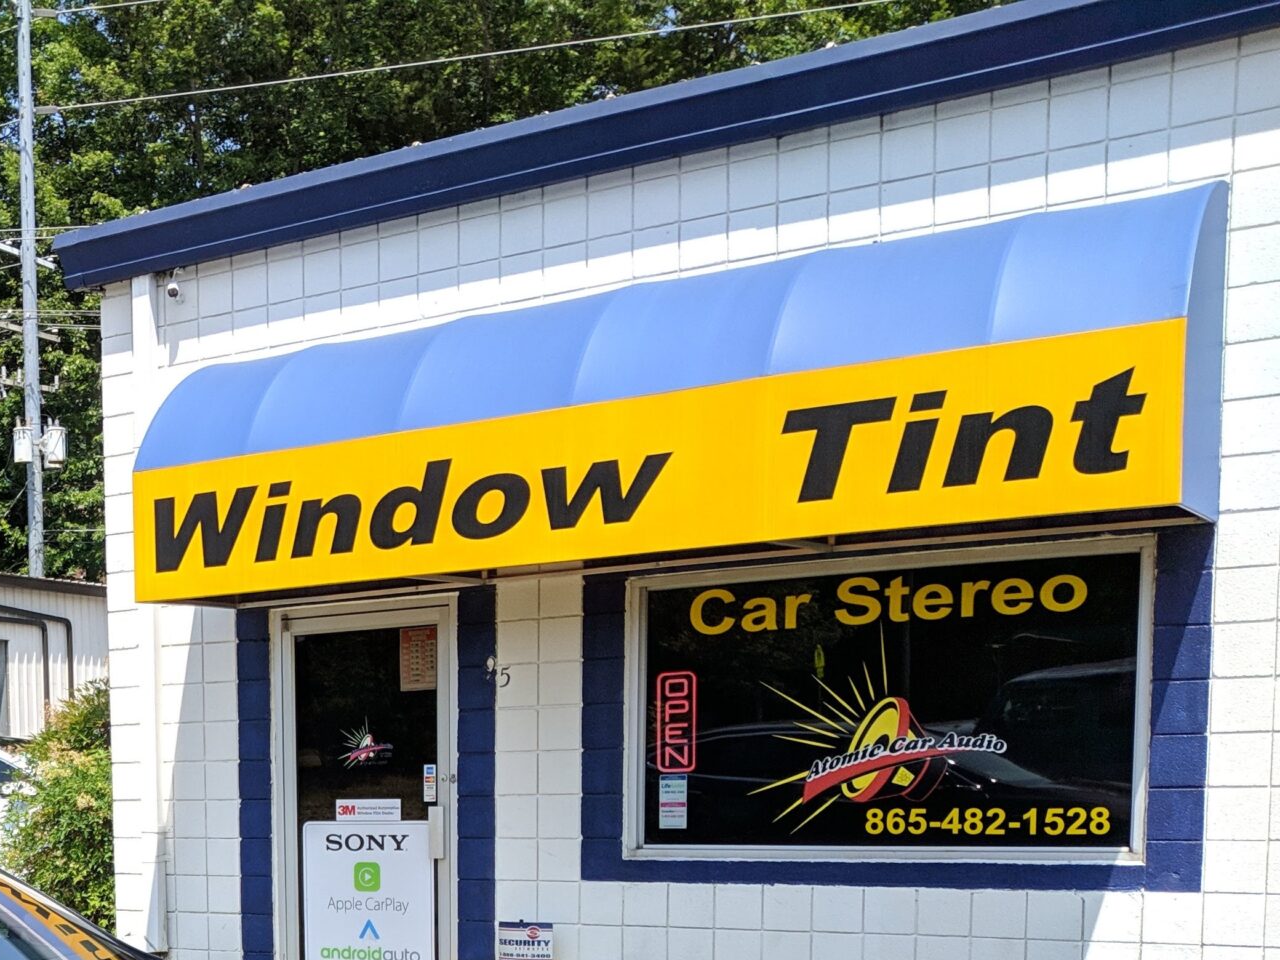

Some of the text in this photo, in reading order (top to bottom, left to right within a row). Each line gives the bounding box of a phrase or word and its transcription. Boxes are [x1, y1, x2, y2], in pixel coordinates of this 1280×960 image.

[152, 365, 1147, 572] Window Tint
[689, 574, 1088, 635] Car Stereo
[664, 678, 689, 767] OPEN
[806, 731, 1007, 781] Atomic Car Audio
[337, 805, 356, 816] 3M
[865, 807, 1111, 836] 865-482-1528
[325, 833, 409, 851] SONY
[327, 896, 409, 916] Apple CarPlay
[499, 938, 551, 947] SECURITY
